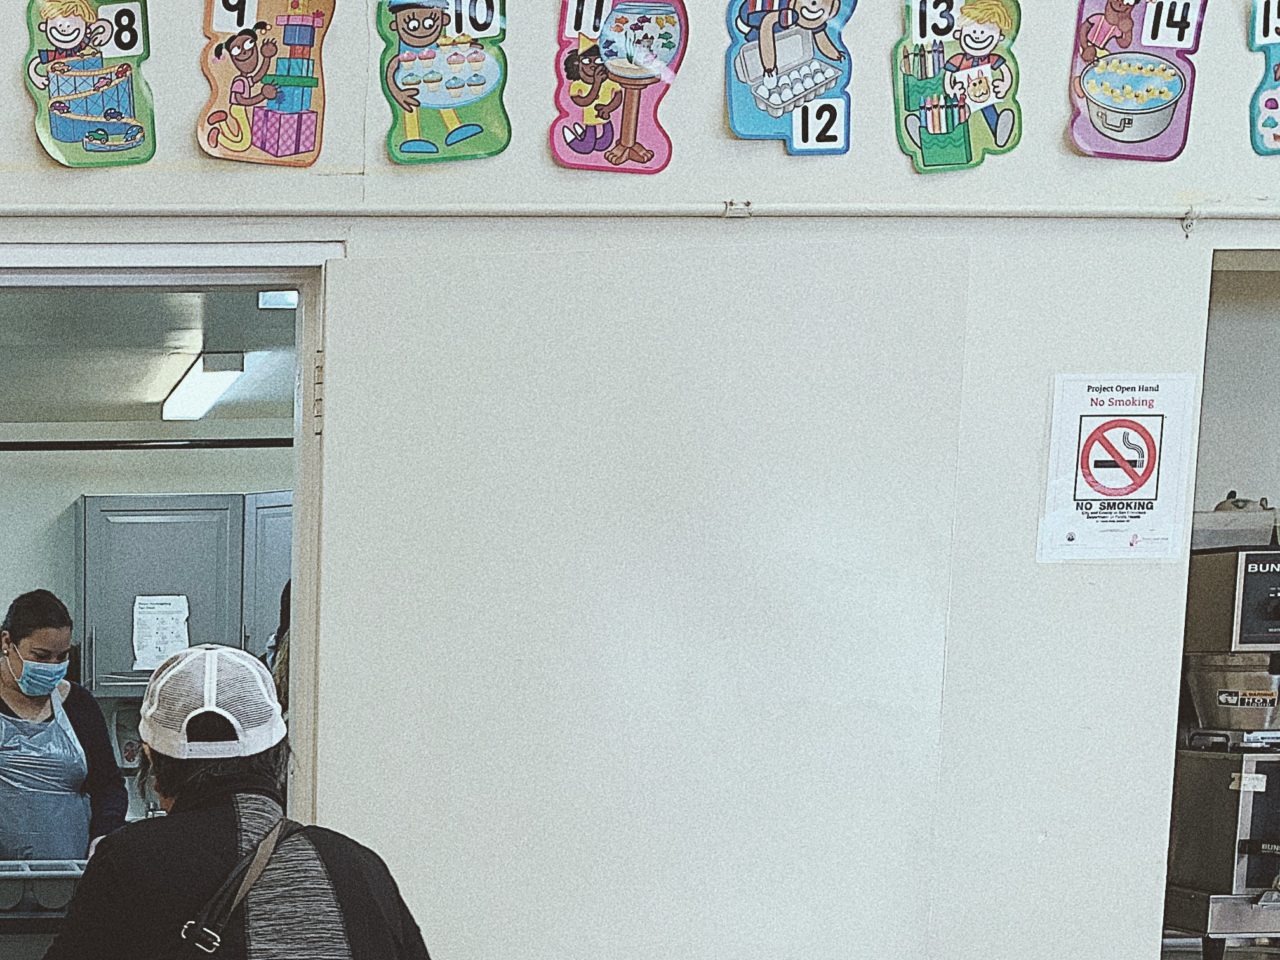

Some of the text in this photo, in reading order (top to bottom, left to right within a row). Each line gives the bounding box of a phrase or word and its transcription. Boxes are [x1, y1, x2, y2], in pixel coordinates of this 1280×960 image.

[113, 8, 139, 51] 8
[454, 0, 495, 34] 10
[573, 0, 605, 32] 11
[918, 0, 955, 39] 13
[1150, 1, 1191, 42] 14
[1262, 0, 1280, 38] 1
[800, 103, 839, 143] 12
[1087, 384, 1160, 394] Project Open Hand
[1090, 397, 1155, 409] No Smoking
[1076, 501, 1154, 511] NO SMOKING
